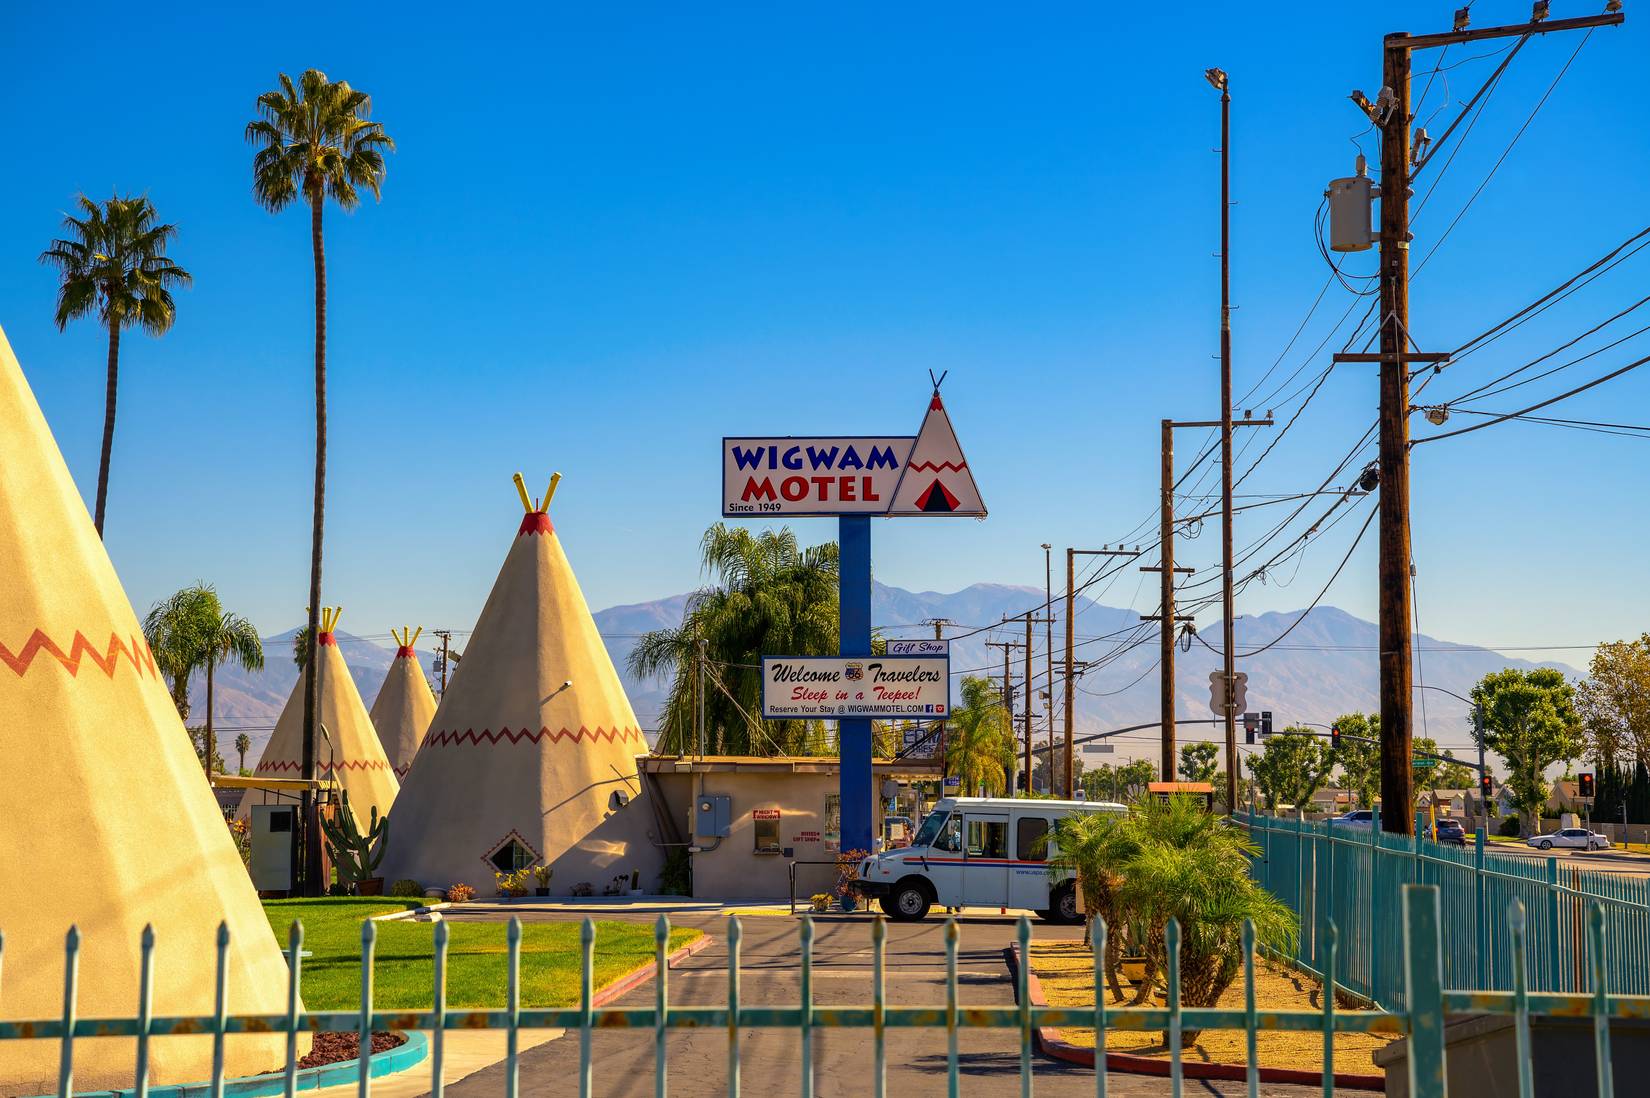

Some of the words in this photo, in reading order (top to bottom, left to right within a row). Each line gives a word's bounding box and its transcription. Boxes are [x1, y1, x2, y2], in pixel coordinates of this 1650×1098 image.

[731, 444, 899, 471] WIGWAM
[740, 475, 880, 502] MOTEL
[729, 503, 754, 512] Since
[758, 503, 782, 512] 1949
[893, 643, 916, 653] Gift
[919, 642, 943, 654] Shop
[771, 663, 840, 683] Welcome
[868, 663, 941, 683] Travelers
[791, 686, 828, 703] Sleep
[835, 689, 849, 700] in
[855, 690, 864, 700] a
[873, 686, 921, 703] Teepee!
[769, 705, 798, 713] Reserve
[800, 705, 817, 713] Your
[819, 705, 835, 714] Stay
[838, 705, 846, 714] @
[847, 705, 924, 713] WIGWAMMOTEL.COM
